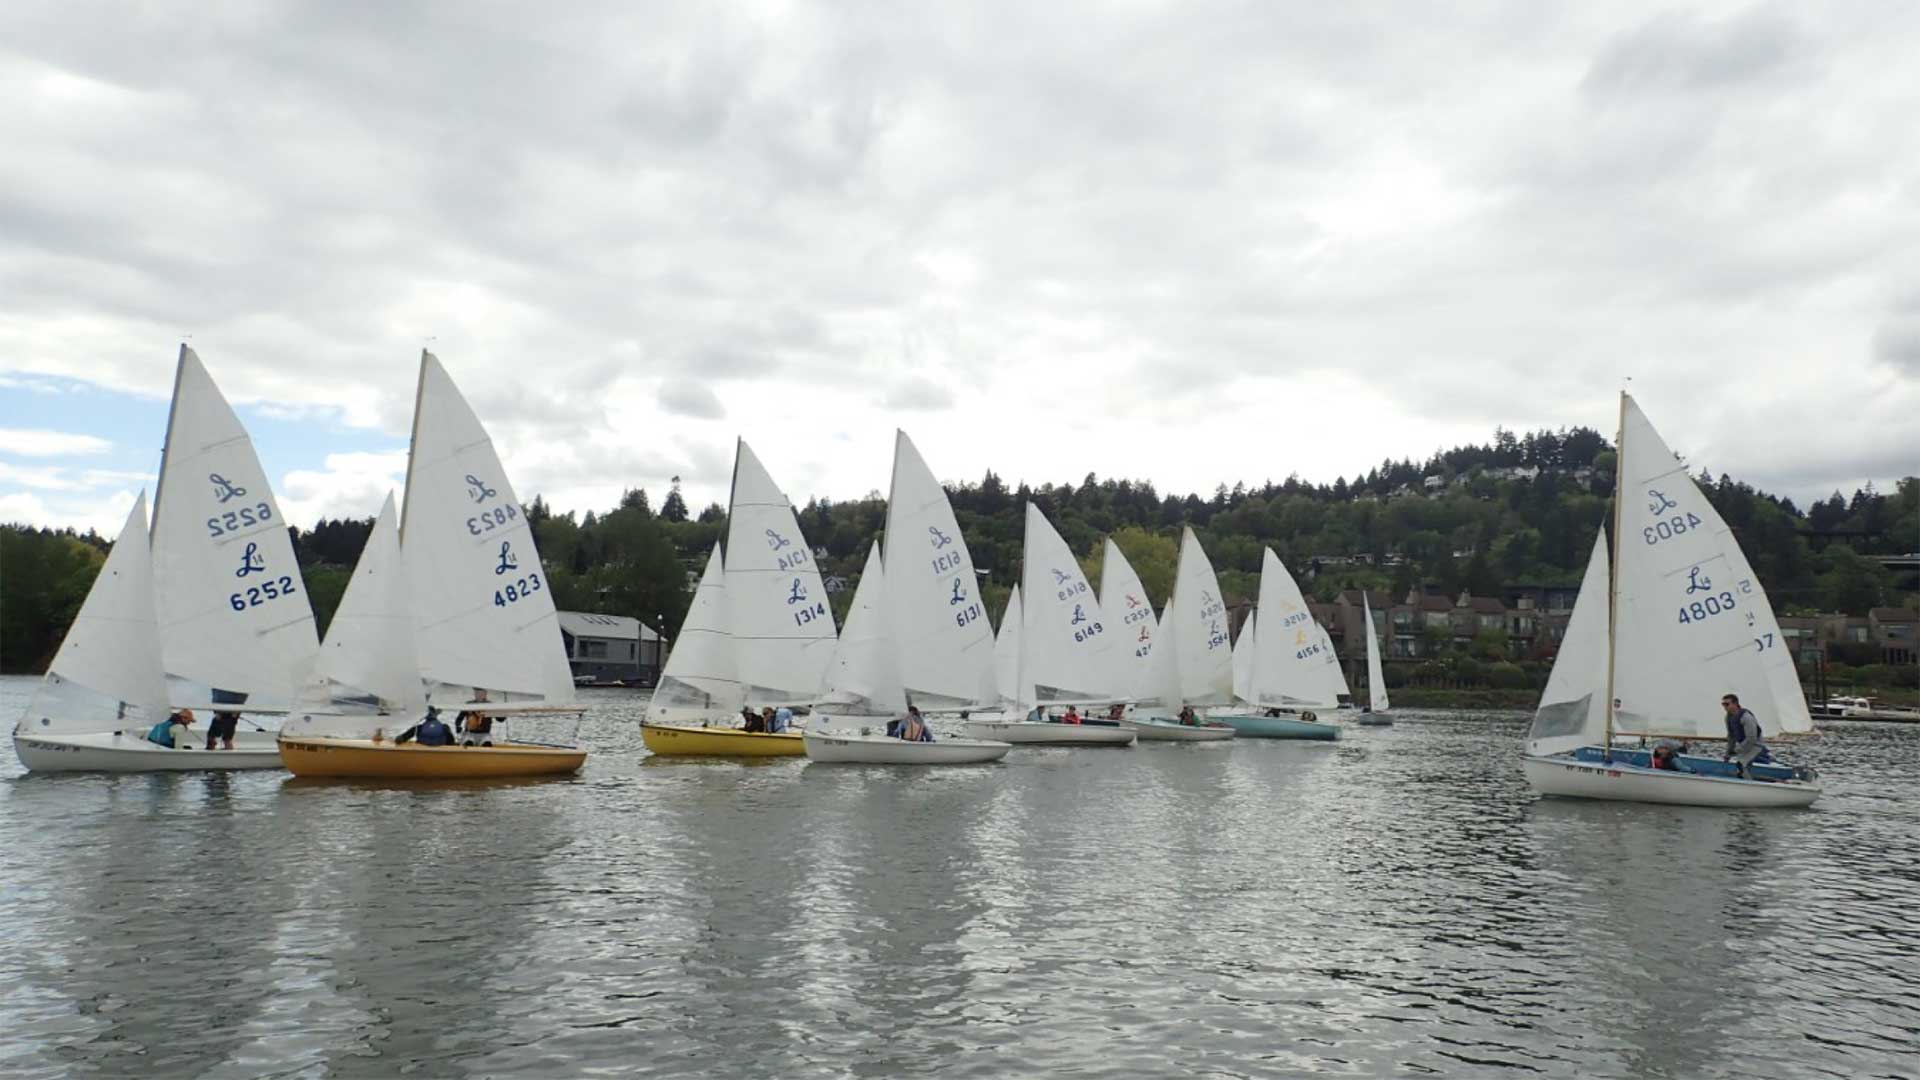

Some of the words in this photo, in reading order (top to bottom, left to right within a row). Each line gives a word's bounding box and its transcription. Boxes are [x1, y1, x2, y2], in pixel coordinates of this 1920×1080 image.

[230, 576, 295, 611] 6252
[495, 573, 541, 607] 4823
[794, 603, 825, 626] 1314
[956, 603, 981, 627] 6131
[1678, 591, 1735, 624] 4803
[1074, 622, 1103, 642] 6149
[1296, 644, 1320, 659] 4156
